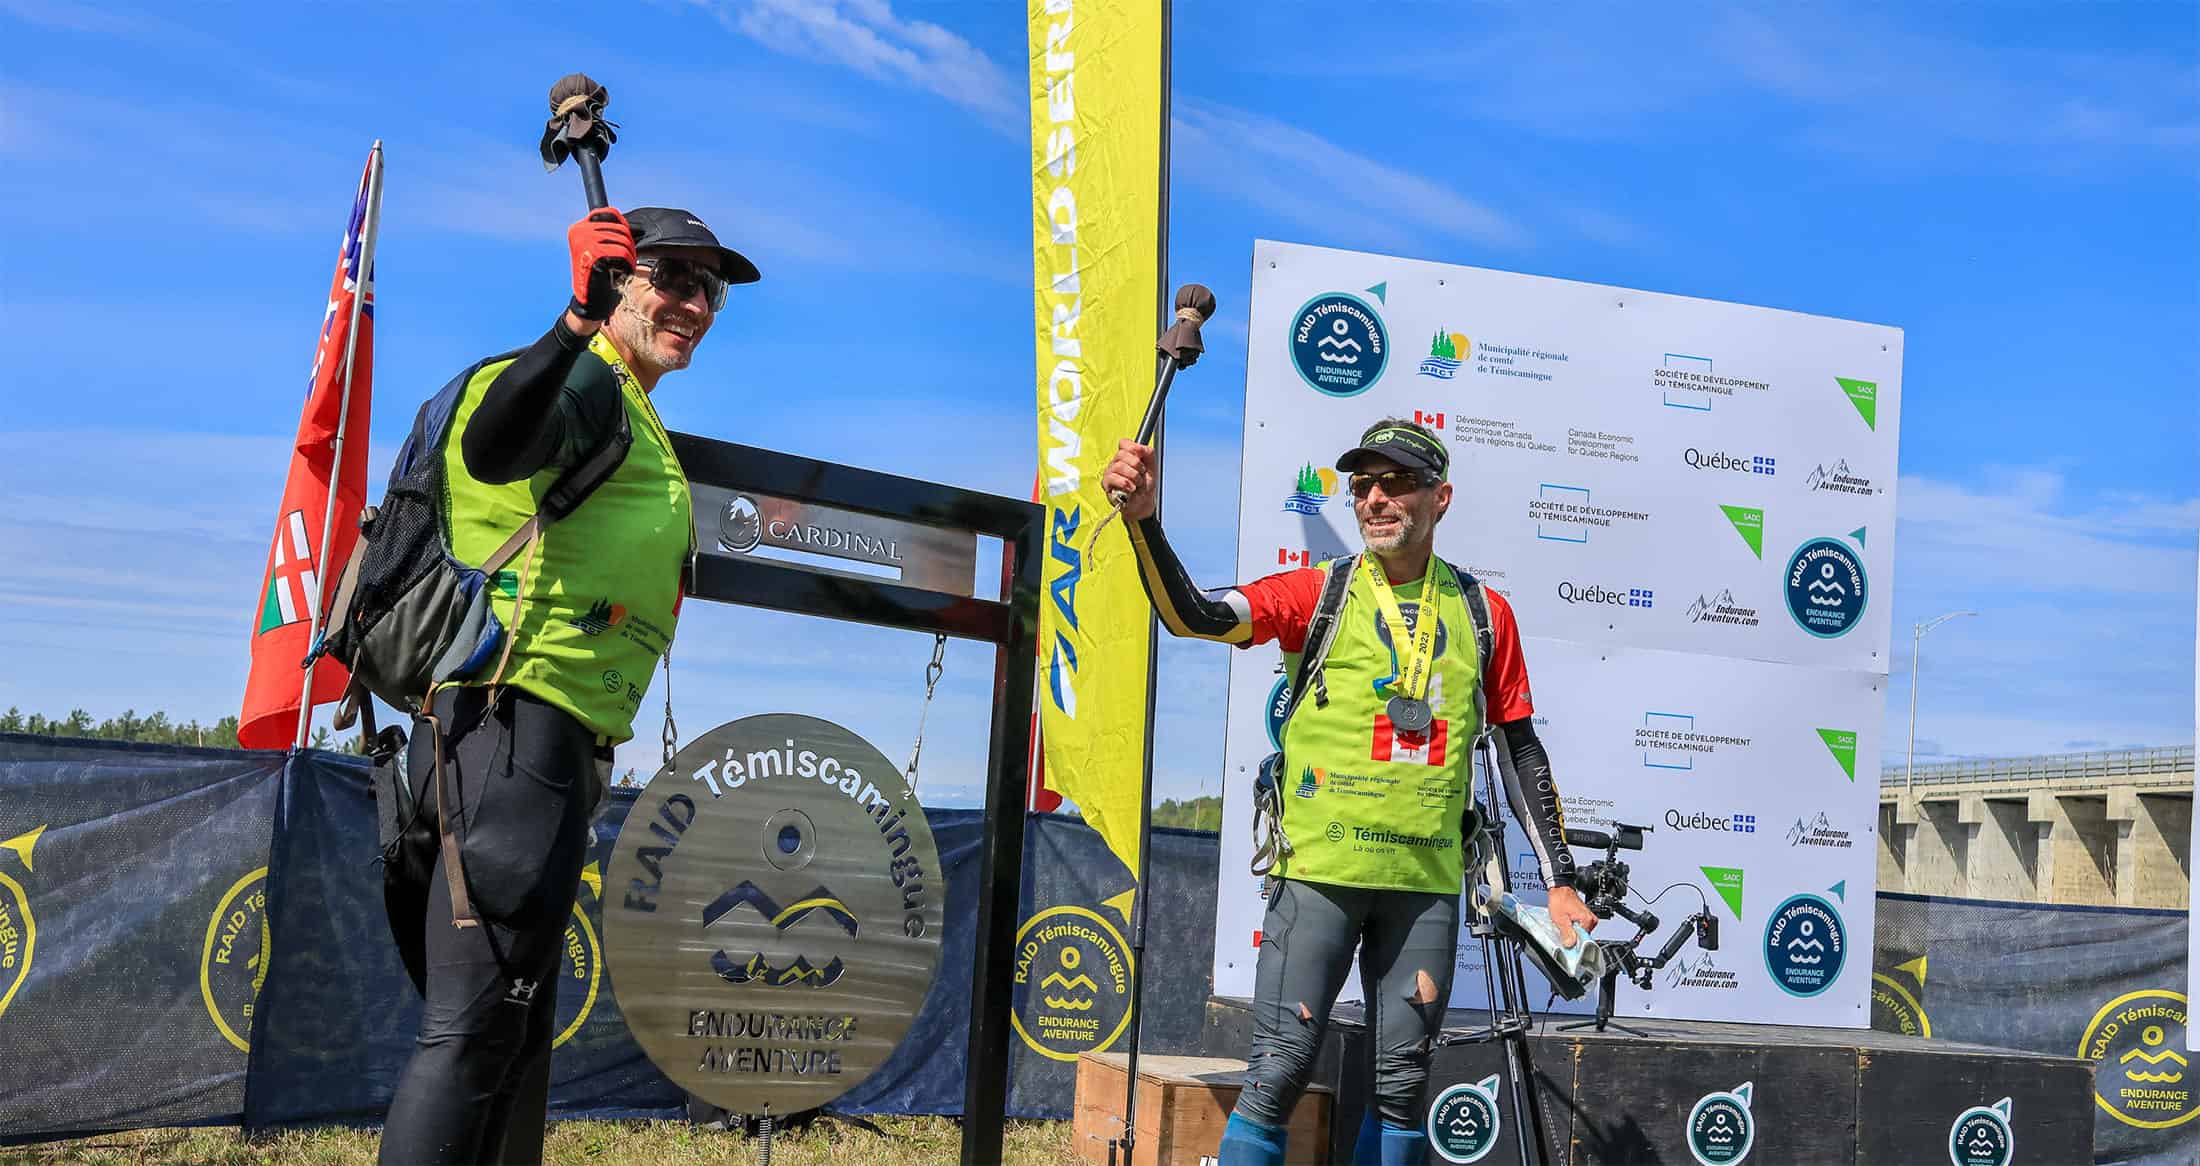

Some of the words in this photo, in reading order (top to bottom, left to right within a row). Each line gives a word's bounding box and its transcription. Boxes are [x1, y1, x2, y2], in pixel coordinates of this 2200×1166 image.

[1297, 314, 1317, 344] RAID
[1313, 302, 1381, 354] Témiscamingue
[1478, 343, 1530, 357] Municipalité
[1531, 350, 1569, 362] régionale
[1478, 353, 1488, 362] de
[1489, 356, 1514, 365] comté
[1315, 365, 1363, 378] ENDURANCE
[1478, 365, 1488, 374] de
[1489, 366, 1553, 382] Témiscamingue
[1654, 368, 1689, 381] SOCIÉTÉ
[1690, 374, 1701, 382] DE
[1703, 374, 1770, 391] DÉVELOPPEMENT
[1318, 374, 1360, 386] AVENTURE
[1654, 378, 1666, 387] DU
[1668, 379, 1733, 396] TÉMISCAMINGUE
[1455, 415, 1514, 430] Développement
[1455, 426, 1502, 437] économique
[1503, 431, 1533, 440] Canada
[1568, 429, 1597, 440] Canada
[1599, 432, 1633, 444] Economic
[1455, 435, 1473, 443] pour
[1475, 436, 1485, 444] les
[1487, 437, 1515, 449] régions
[1516, 439, 1526, 448] du
[1527, 439, 1557, 453] Québec
[1568, 438, 1616, 451] Development
[1568, 446, 1578, 455] for
[1609, 451, 1639, 463] Regions
[1684, 448, 1751, 473] Québec
[1820, 480, 1873, 496] Aventure.com
[1832, 473, 1870, 487] Endurance
[1529, 500, 1565, 513] SOCIÉTÉ
[1567, 504, 1579, 513] DE
[1580, 505, 1649, 522] DÉVELOPPEMENT
[1529, 511, 1542, 520] DU
[1543, 511, 1611, 527] TÉMISCAMINGUE
[768, 520, 903, 561] CARDINAL
[1791, 559, 1808, 588] RAID
[1804, 547, 1861, 596] Témiscamingue
[1558, 581, 1626, 606] Québec
[1715, 604, 1756, 617] Endurance
[1806, 608, 1845, 620] ENDURANCE
[1701, 612, 1759, 627] Aventure.com
[1808, 617, 1842, 627] AVENTURE
[1418, 631, 1430, 655] 2023
[1274, 687, 1292, 719] RAID
[1635, 728, 1670, 740] SOCIÉTÉ
[1671, 732, 1683, 741] DE
[1684, 732, 1751, 747] DÉVELOPPEMENT
[1635, 738, 1647, 748] DU
[1649, 739, 1715, 753] TÉMISCAMINGUE
[1664, 809, 1731, 832] Québec
[623, 793, 696, 913] RAID
[692, 739, 928, 939] Témiscamingue
[1353, 827, 1454, 851] Témiscamingue
[1812, 827, 1849, 840] Endurance
[1799, 835, 1852, 849] Aventure.com
[1770, 918, 1788, 947] RAID
[1784, 903, 1841, 953] Témiscamingue
[215, 910, 247, 964] RAID
[1015, 941, 1039, 984] RAID
[1035, 922, 1126, 994] Témiscamingue
[1695, 968, 1736, 980] Endurance
[1785, 967, 1825, 977] ENDURANCE
[1680, 979, 1739, 990] Aventure.com
[1787, 976, 1822, 985] AVENTURE
[687, 1009, 858, 1041] ENDURANCE
[1038, 1016, 1100, 1030] ENDURANCE
[1042, 1029, 1095, 1041] AVENTURE
[2091, 1023, 2119, 1059] RAID
[697, 1046, 842, 1075] AVENTURE
[2120, 1088, 2188, 1101] ENDURANCE
[2126, 1100, 2182, 1111] AVENTURE
